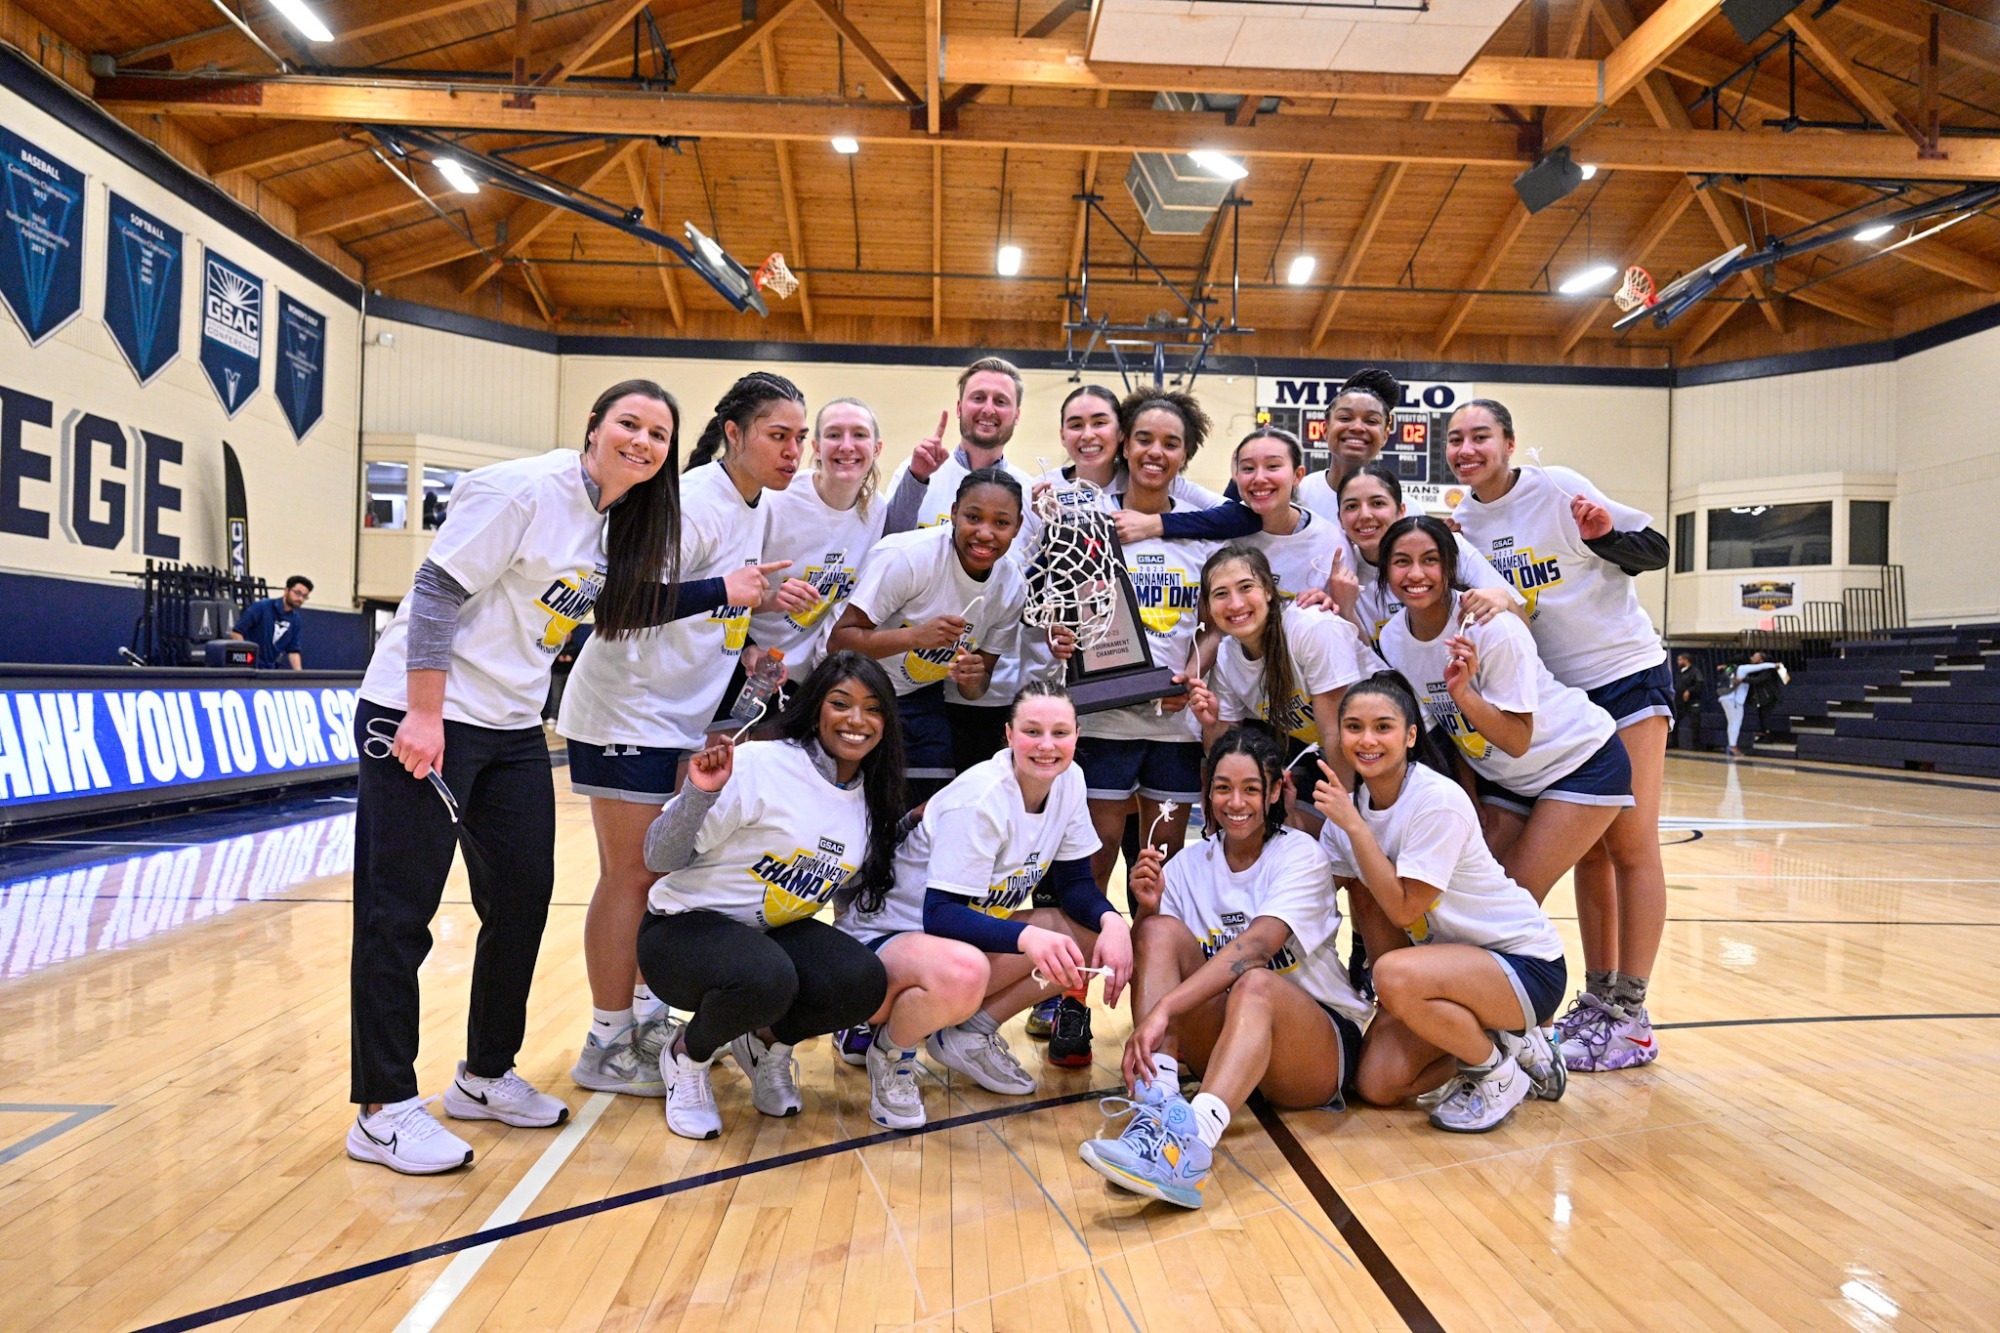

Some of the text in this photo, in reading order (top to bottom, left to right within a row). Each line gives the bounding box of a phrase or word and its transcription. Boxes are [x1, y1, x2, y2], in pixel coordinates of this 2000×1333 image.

[21, 149, 60, 181] BASEBALL
[130, 212, 165, 241] SOFTBALL
[207, 294, 258, 339] GSAC
[206, 325, 257, 355] CONFERENCE
[1276, 380, 1455, 409] MELO
[1397, 414, 1427, 422] VISITOR
[1403, 424, 1426, 443] 02
[1493, 538, 1513, 549] GSAC
[1494, 550, 1513, 559] 2023
[1092, 639, 1129, 650] TOURNAMENT
[1096, 646, 1129, 658] CHAMPIONS
[104, 690, 205, 784] YOU
[200, 689, 257, 774] TO
[253, 689, 330, 769] OUR
[820, 839, 843, 854] GSAC
[815, 851, 839, 865] 2023
[792, 854, 850, 883] TOURNAMENT
